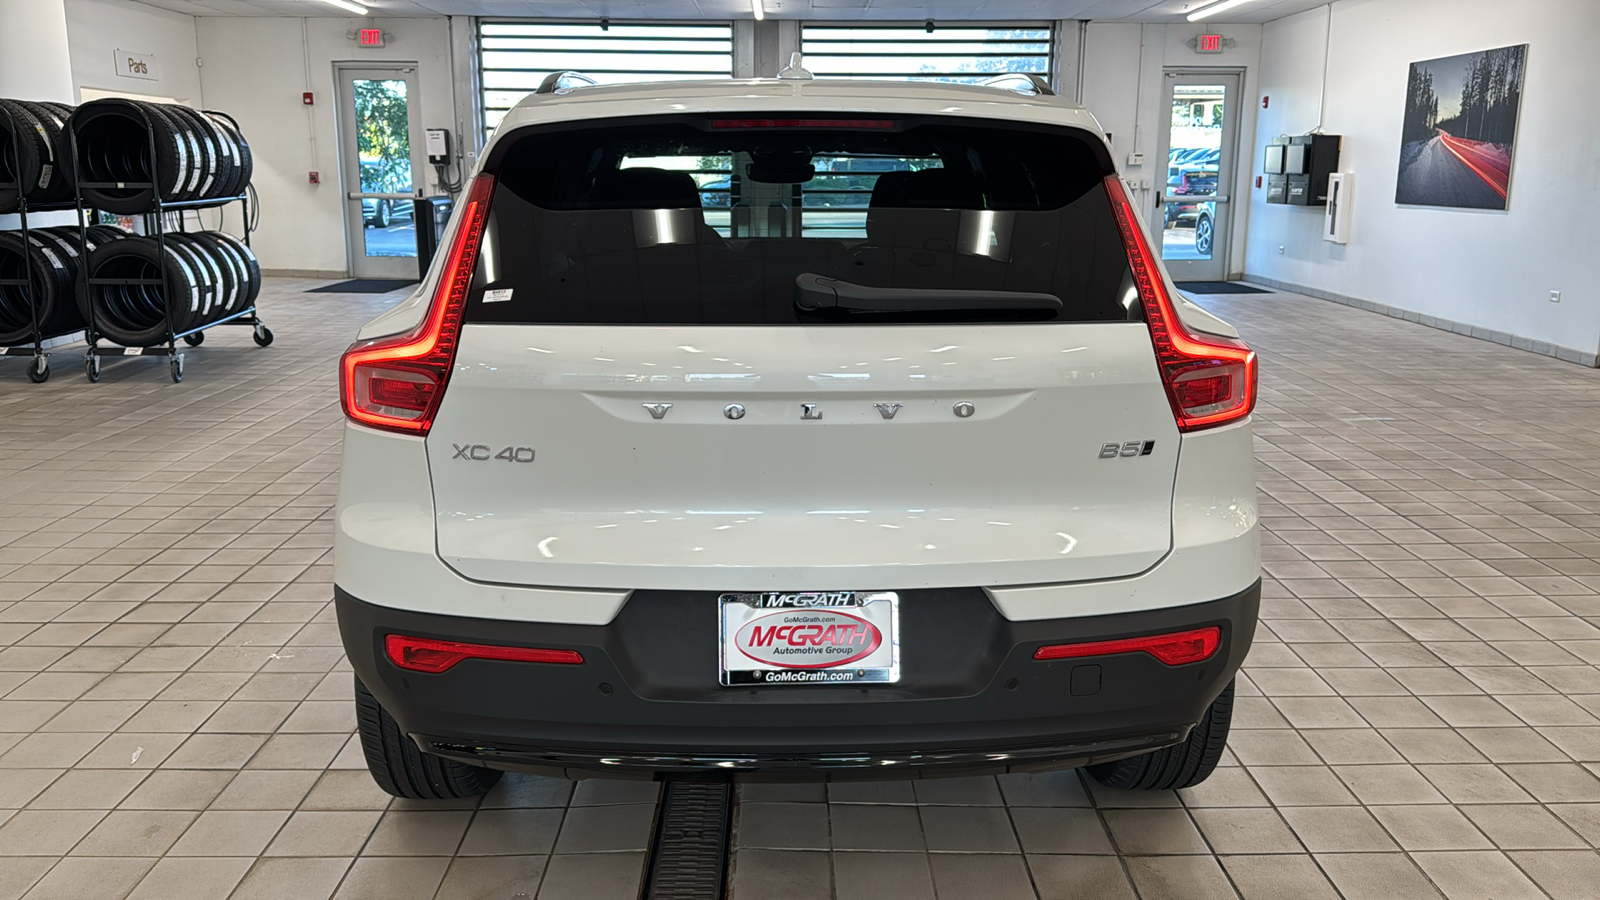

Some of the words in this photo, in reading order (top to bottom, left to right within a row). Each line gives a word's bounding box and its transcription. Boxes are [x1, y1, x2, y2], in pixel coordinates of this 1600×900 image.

[360, 29, 380, 45] EXIT
[1201, 34, 1220, 50] EXIT
[127, 57, 148, 75] Parts
[642, 400, 975, 420] VOLVO
[773, 646, 823, 655] Automotive
[825, 646, 853, 655] Group
[765, 671, 854, 682] GoMcGrath.com
